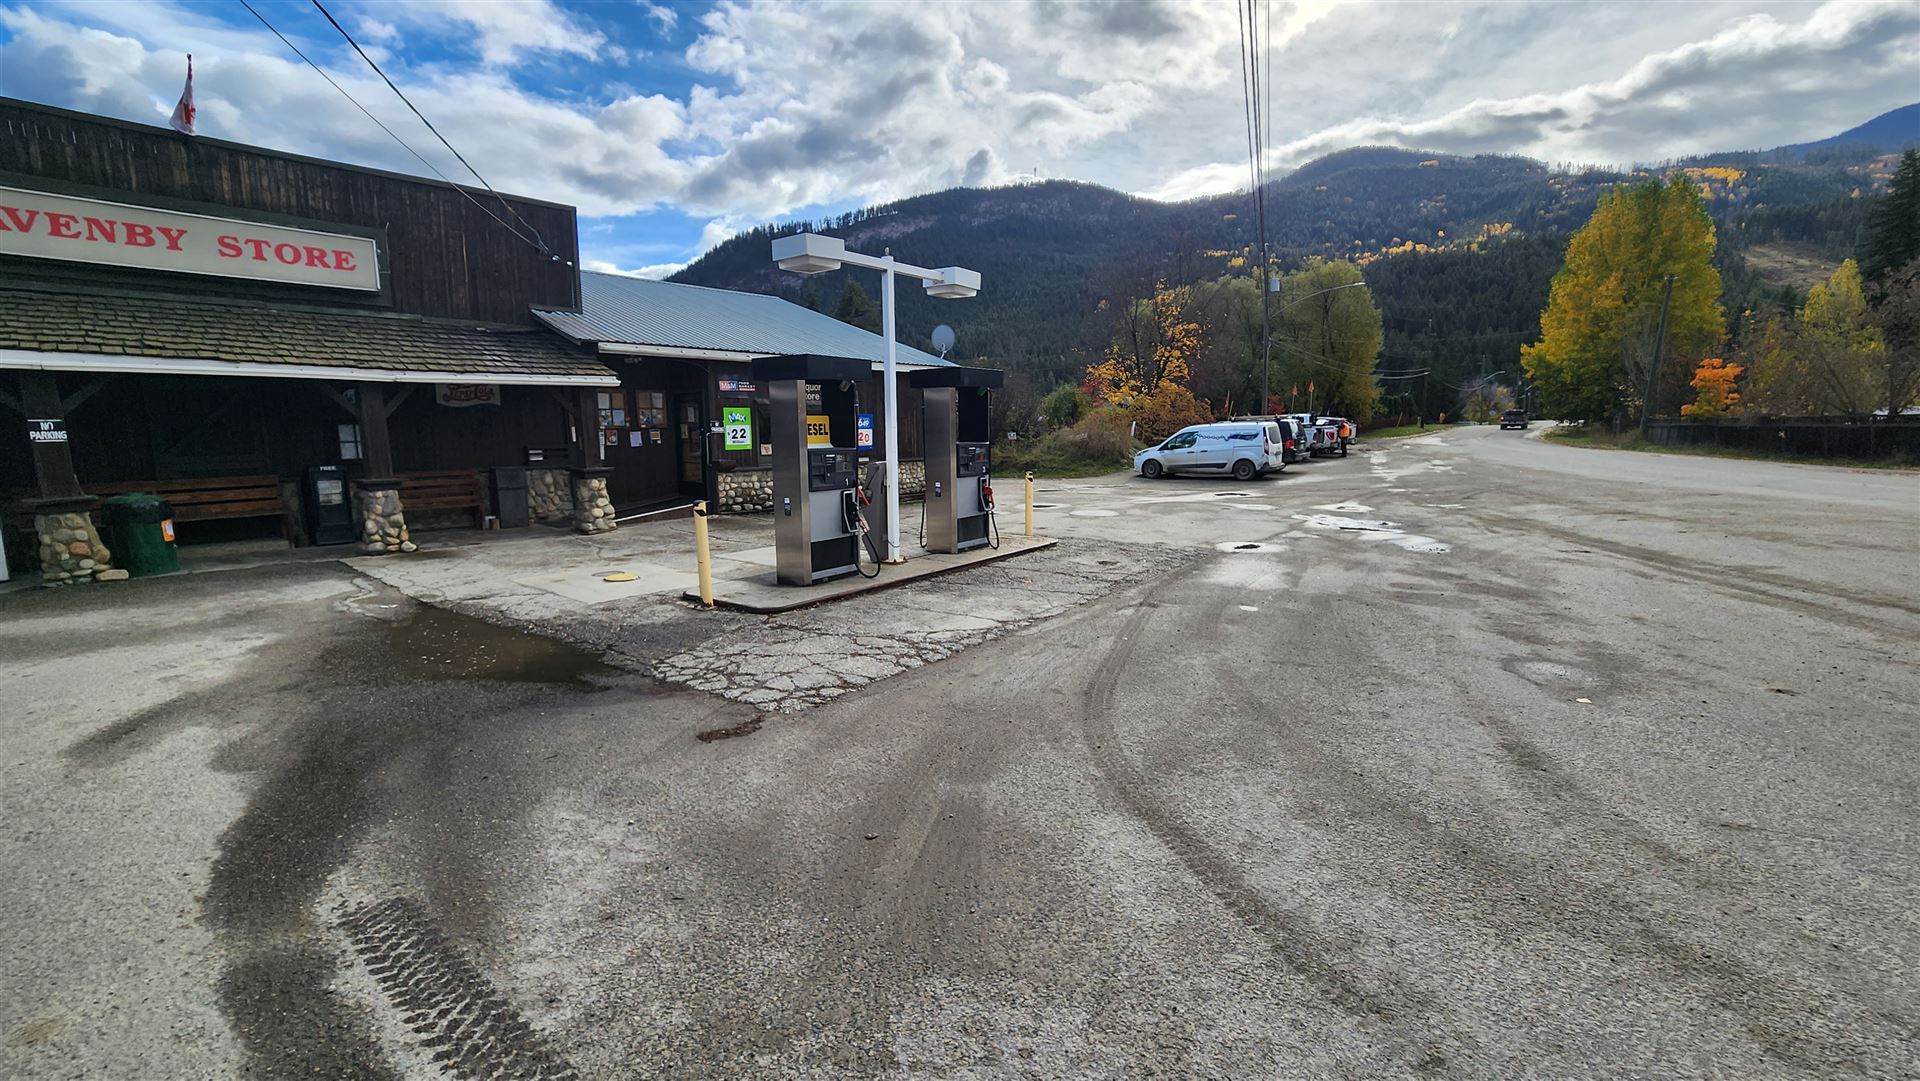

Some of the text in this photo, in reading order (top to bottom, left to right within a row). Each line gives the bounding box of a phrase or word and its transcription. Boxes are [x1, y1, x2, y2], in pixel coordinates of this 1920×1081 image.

[217, 235, 357, 272] STORE
[805, 383, 821, 393] quor
[805, 392, 820, 400] ore
[39, 422, 54, 431] NO
[807, 423, 829, 436] ESEL
[29, 431, 68, 440] PARKING
[731, 428, 747, 440] 22
[858, 432, 870, 443] 20
[845, 478, 849, 486] 1
